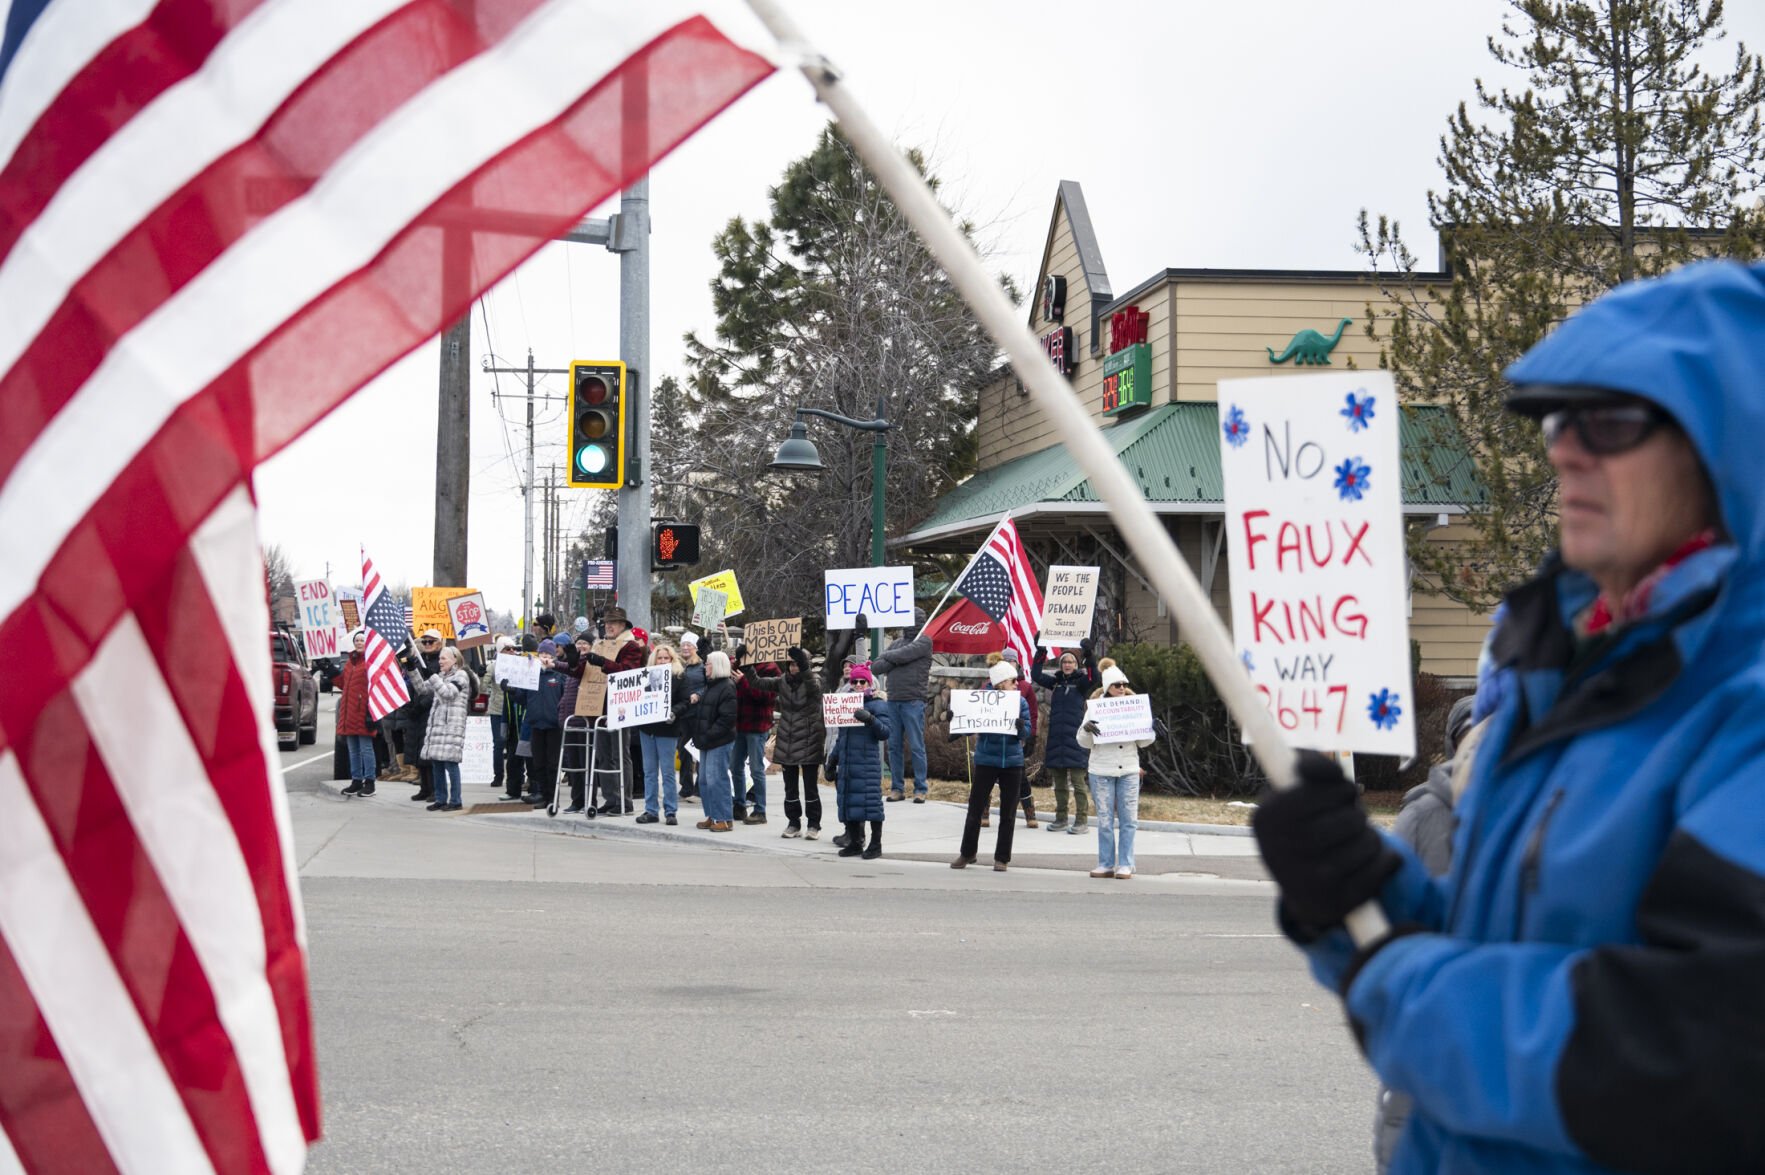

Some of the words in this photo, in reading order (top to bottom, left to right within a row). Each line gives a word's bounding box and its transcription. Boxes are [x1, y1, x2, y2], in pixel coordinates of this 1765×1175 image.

[1242, 510, 1373, 573] FAUX
[1055, 573, 1070, 582] WE
[1076, 573, 1091, 583] THE
[300, 581, 329, 601] END
[1052, 585, 1084, 596] PEOPLE
[419, 599, 447, 612] ANG
[826, 582, 911, 616] PEACE
[306, 602, 330, 627] ICE
[457, 607, 480, 621] STOP
[1048, 603, 1087, 615] DEMAND
[1250, 591, 1368, 644] KING
[745, 622, 766, 637] This
[767, 621, 776, 635] Is
[778, 620, 800, 634] Our
[949, 621, 992, 635] Coca-Cola
[305, 627, 337, 657] NOW
[745, 634, 799, 649] MORAL
[744, 648, 788, 665] MOME
[1274, 654, 1333, 682] WAY
[616, 674, 642, 690] HONK
[613, 689, 642, 705] TRUMP
[823, 694, 838, 704] We
[841, 693, 863, 704] want
[968, 690, 1006, 705] STOP
[635, 701, 658, 718] LIST!
[824, 714, 836, 725] Not
[952, 710, 1015, 731] Insanity
